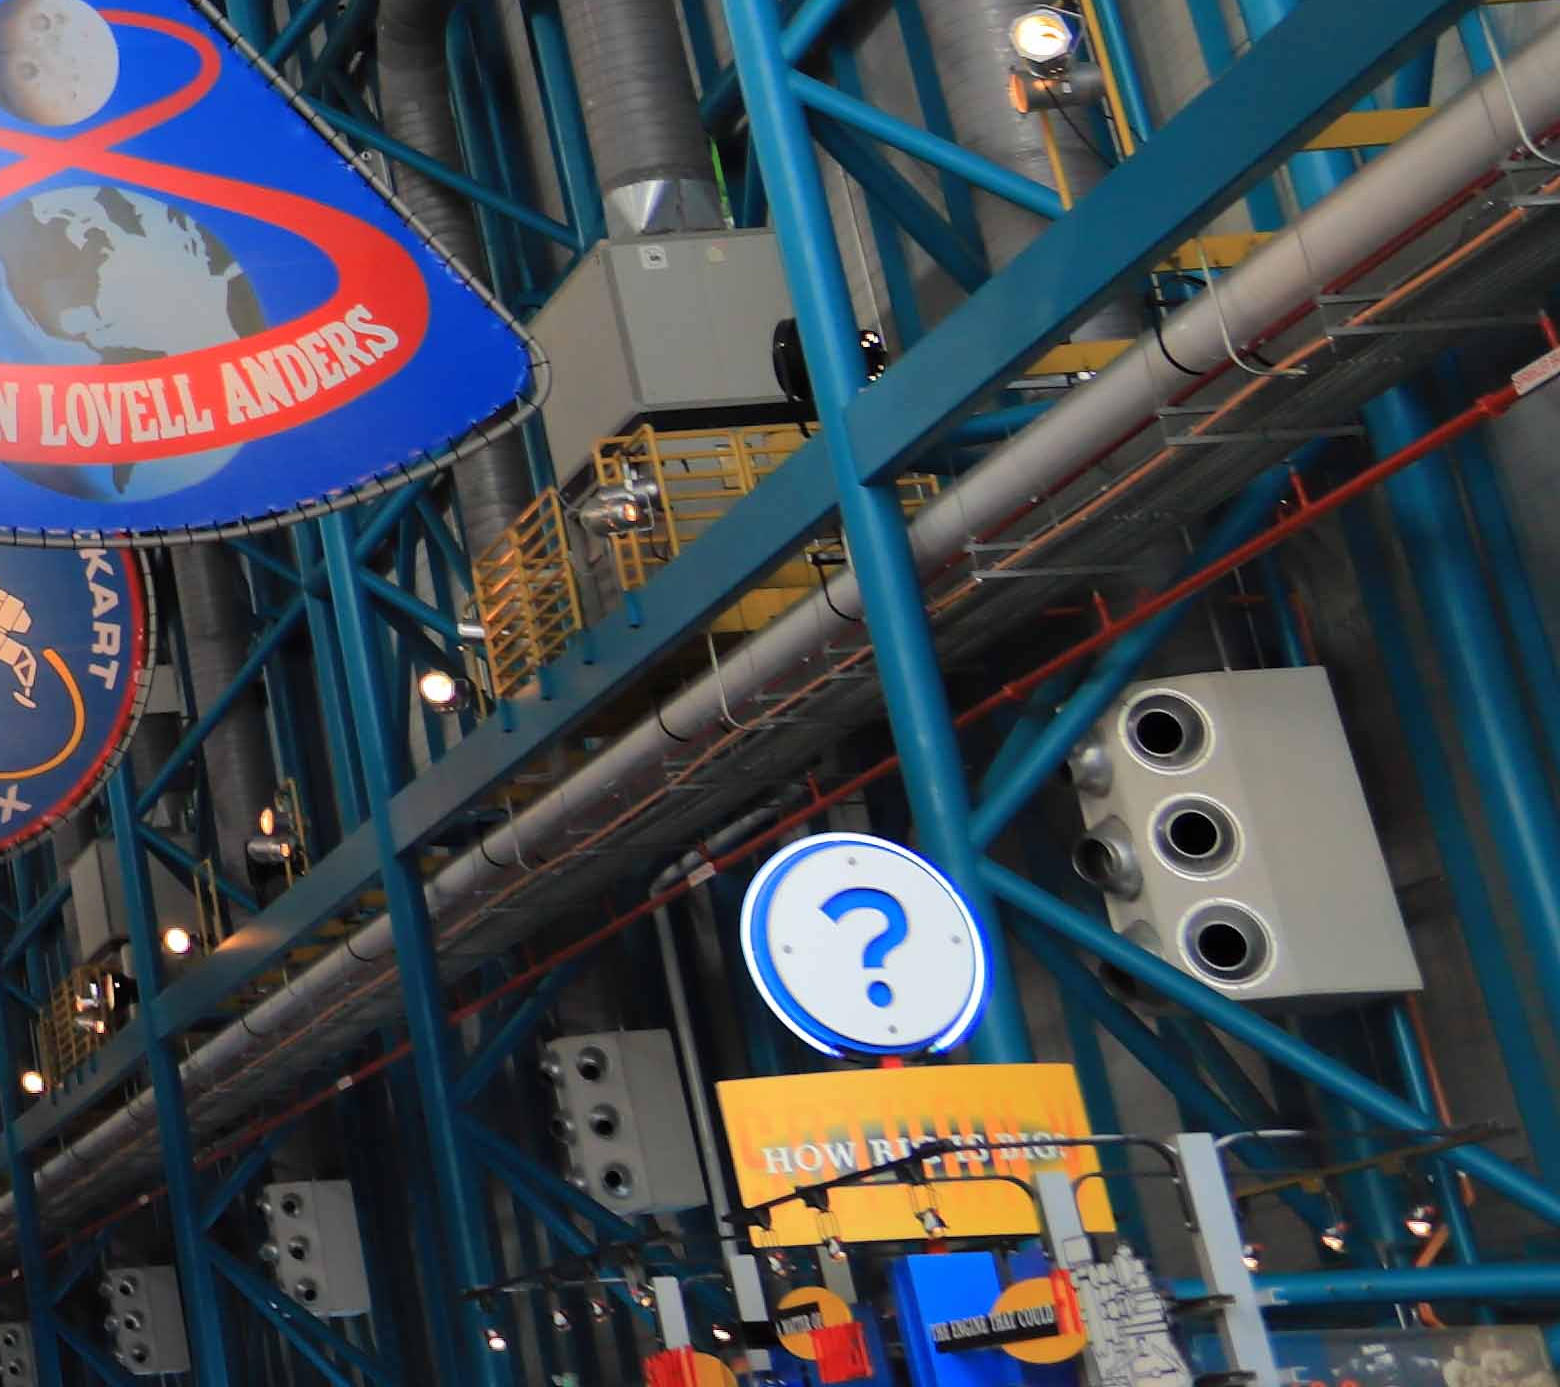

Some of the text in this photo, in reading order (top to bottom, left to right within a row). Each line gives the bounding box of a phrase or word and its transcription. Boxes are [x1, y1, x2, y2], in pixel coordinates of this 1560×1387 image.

[39, 372, 214, 448] LOVELL
[222, 305, 400, 424] ANDERS
[762, 1143, 857, 1173] HOW
